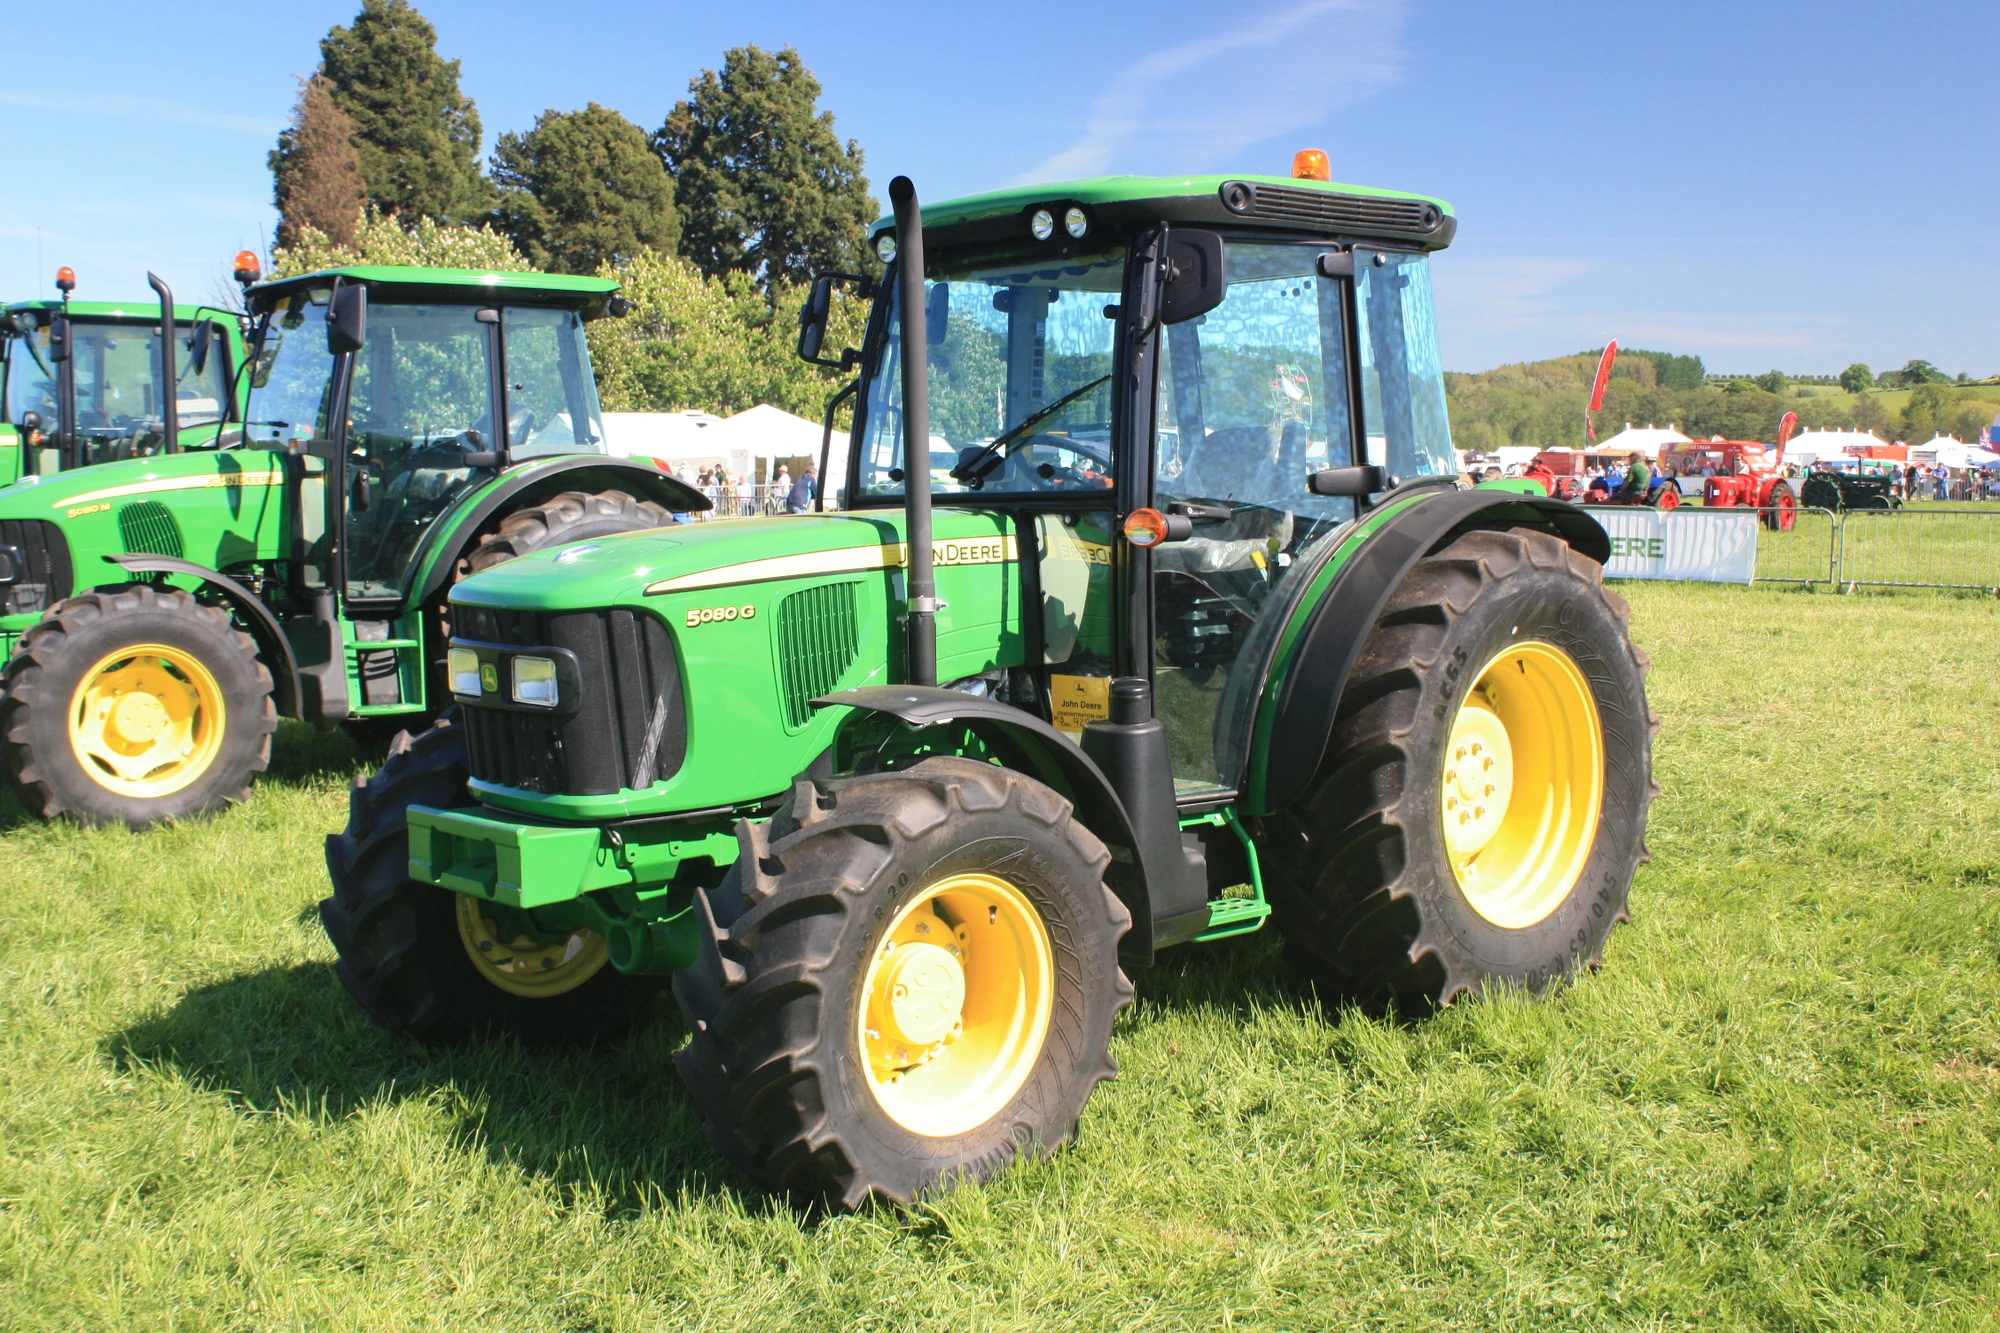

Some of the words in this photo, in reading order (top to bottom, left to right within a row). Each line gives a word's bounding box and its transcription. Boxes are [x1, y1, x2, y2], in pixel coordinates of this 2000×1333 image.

[205, 476, 237, 488] JOHN
[239, 474, 276, 486] DEERE
[898, 547, 943, 565] JN
[946, 544, 1001, 561] DEERE
[1610, 537, 1664, 558] ERE
[686, 606, 739, 628] 5080
[740, 604, 756, 619] G
[1057, 711, 1095, 719] DEMONSTRATION
[1061, 700, 1079, 709] John
[1080, 700, 1102, 710] Deere
[871, 904, 885, 922] R
[886, 870, 909, 900] 20
[1553, 953, 1565, 977] R
